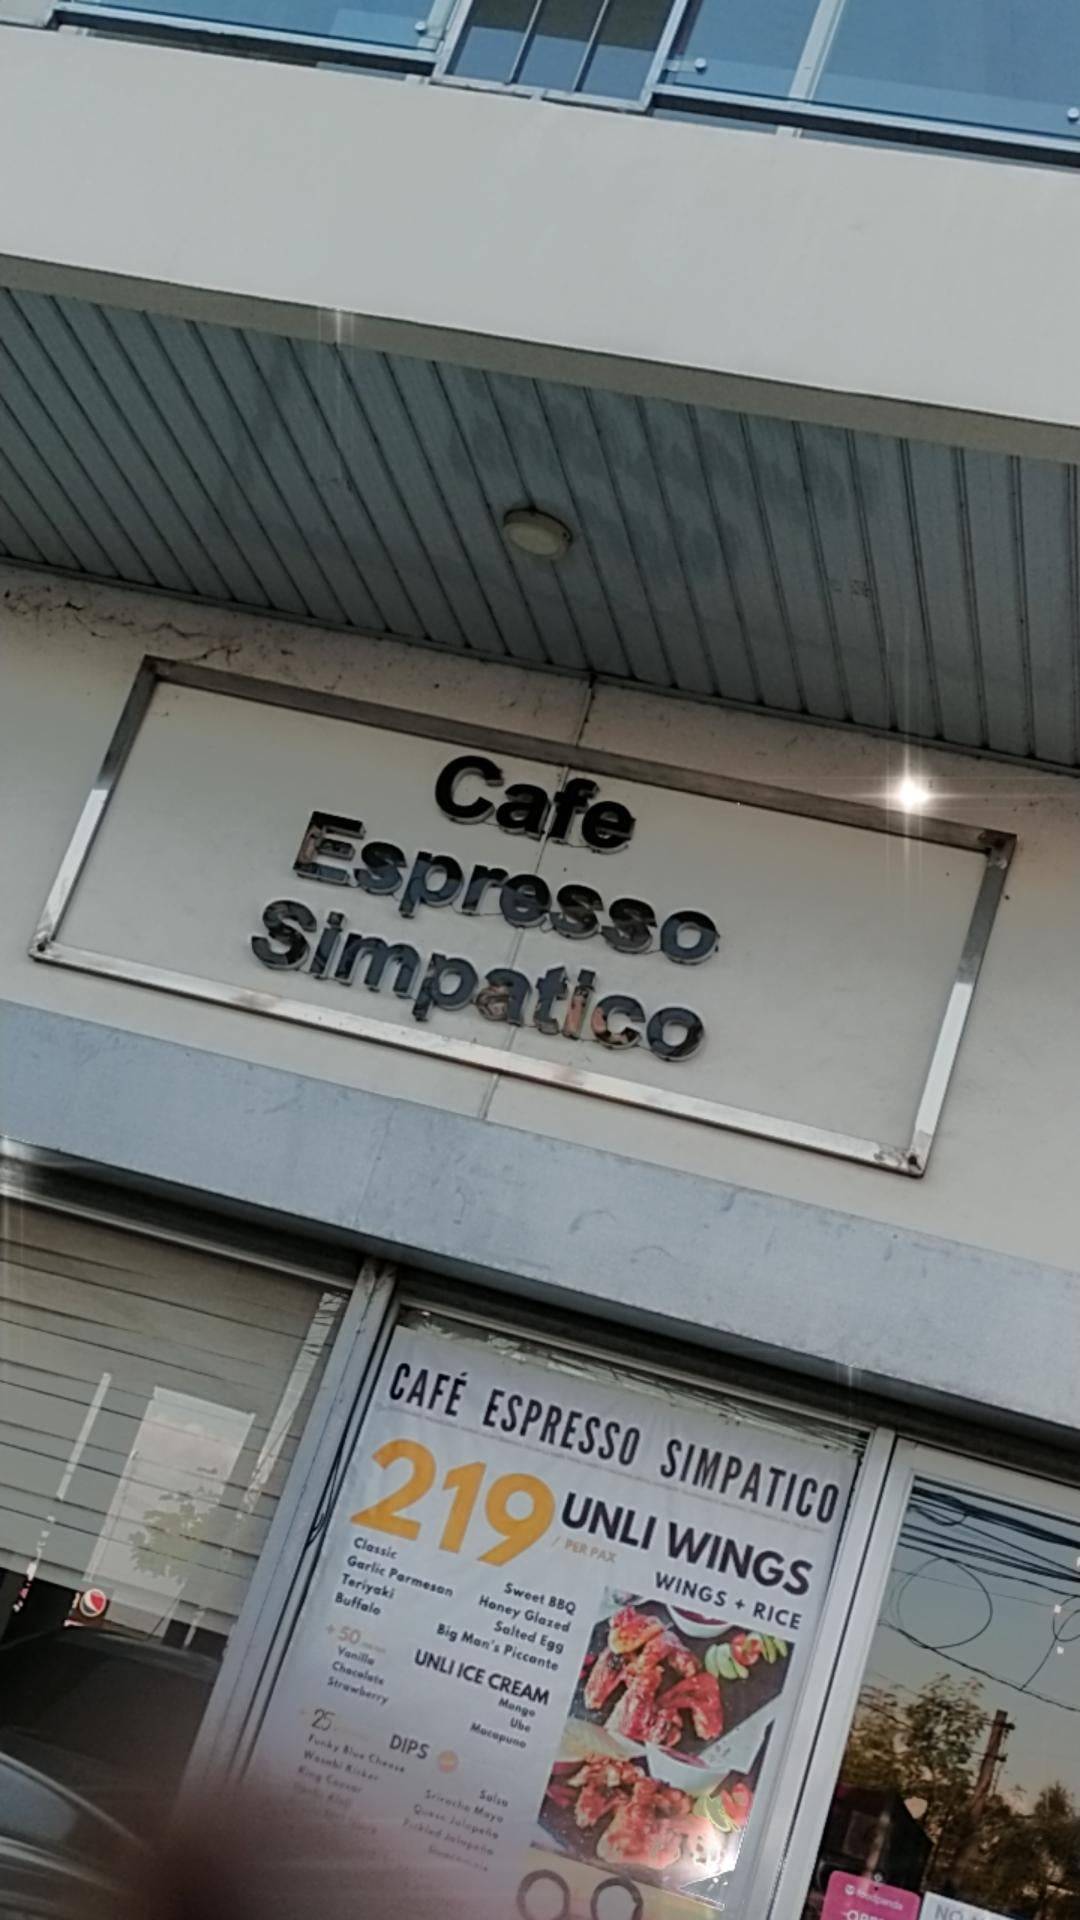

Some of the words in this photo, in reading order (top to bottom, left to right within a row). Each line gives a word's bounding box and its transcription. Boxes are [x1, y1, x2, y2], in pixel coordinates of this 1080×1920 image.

[435, 754, 637, 854] Cafe
[293, 811, 720, 966] Espresso
[251, 899, 706, 1062] Simpatico
[389, 1361, 469, 1417] CAFÉ
[482, 1388, 641, 1466] ESPRESSO
[660, 1438, 840, 1524] SIMPATICO
[350, 1438, 556, 1568] 219
[353, 1537, 398, 1560] Classic
[561, 1492, 657, 1550] UNLI
[668, 1521, 814, 1596] WINGS
[564, 1538, 591, 1557] PER
[590, 1544, 618, 1563] PAX
[341, 1573, 395, 1600] Teriyaki
[347, 1555, 385, 1577] Garlic
[388, 1568, 454, 1598] Parmesan
[335, 1592, 381, 1616] Buffalo
[478, 1595, 520, 1620] Honey
[524, 1609, 571, 1633] Glazed
[504, 1583, 545, 1606] Sweet
[548, 1595, 577, 1616] BBQ
[655, 1571, 727, 1608] WINGS
[752, 1601, 803, 1631] RICE
[436, 1624, 457, 1644] Big
[461, 1631, 499, 1653] Man's
[504, 1644, 559, 1672] Piccante
[494, 1620, 536, 1643] Salted
[540, 1635, 565, 1655] Egg
[332, 1661, 384, 1685] Chocolate
[338, 1645, 375, 1666] Vanilla
[327, 1676, 389, 1705] Strawberry
[414, 1649, 455, 1675] UNLI
[456, 1661, 484, 1685] ICE
[488, 1672, 550, 1705] CREAM
[498, 1698, 536, 1718] Mango
[510, 1717, 531, 1733] Ube
[389, 1734, 430, 1759] DIPS
